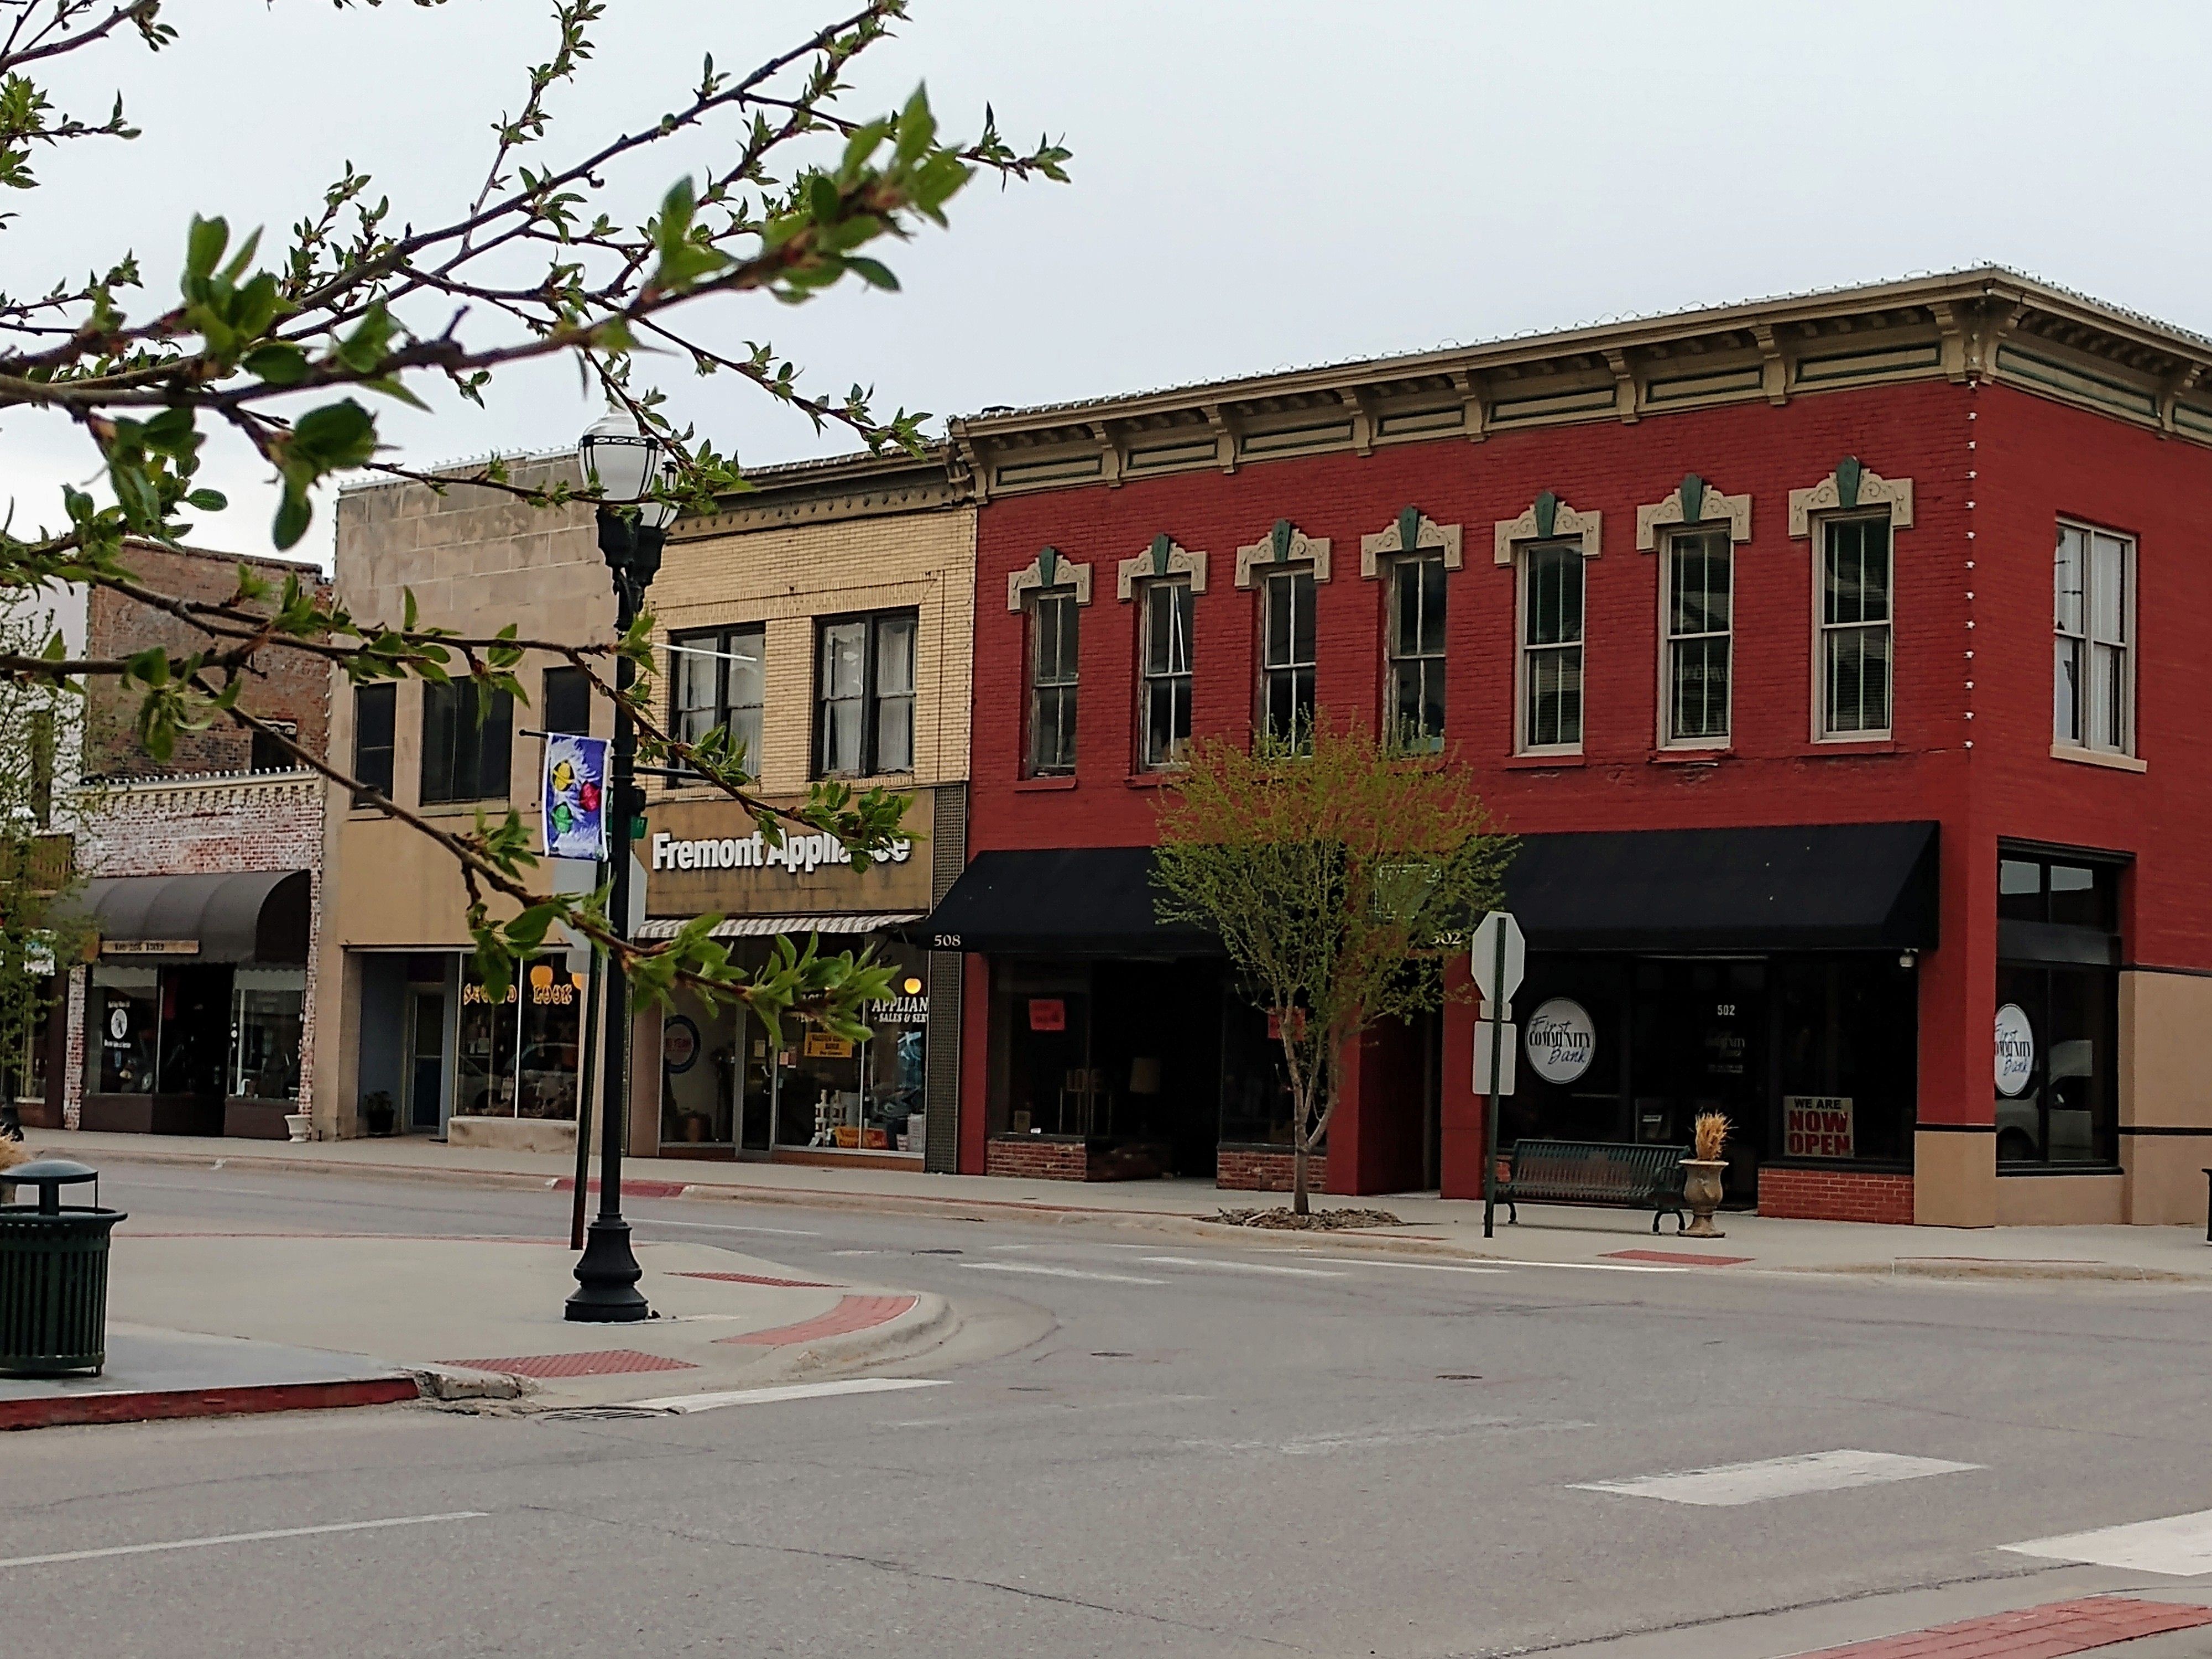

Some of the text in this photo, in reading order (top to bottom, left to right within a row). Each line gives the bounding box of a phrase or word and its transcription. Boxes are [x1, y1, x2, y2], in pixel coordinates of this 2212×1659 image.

[653, 828, 911, 873] Fremont Appliace
[934, 934, 961, 947] 508
[463, 983, 572, 1005] SECD LOOK
[879, 1013, 902, 1022] SALES
[1717, 1005, 1735, 1016] 502
[1532, 1015, 1572, 1034] First
[1529, 1031, 1590, 1047] COMMUNITY
[1548, 1045, 1584, 1065] Bank
[1794, 1098, 1841, 1109] WE ARE
[1789, 1110, 1848, 1133] NOW
[1789, 1134, 1850, 1156] OPEN
